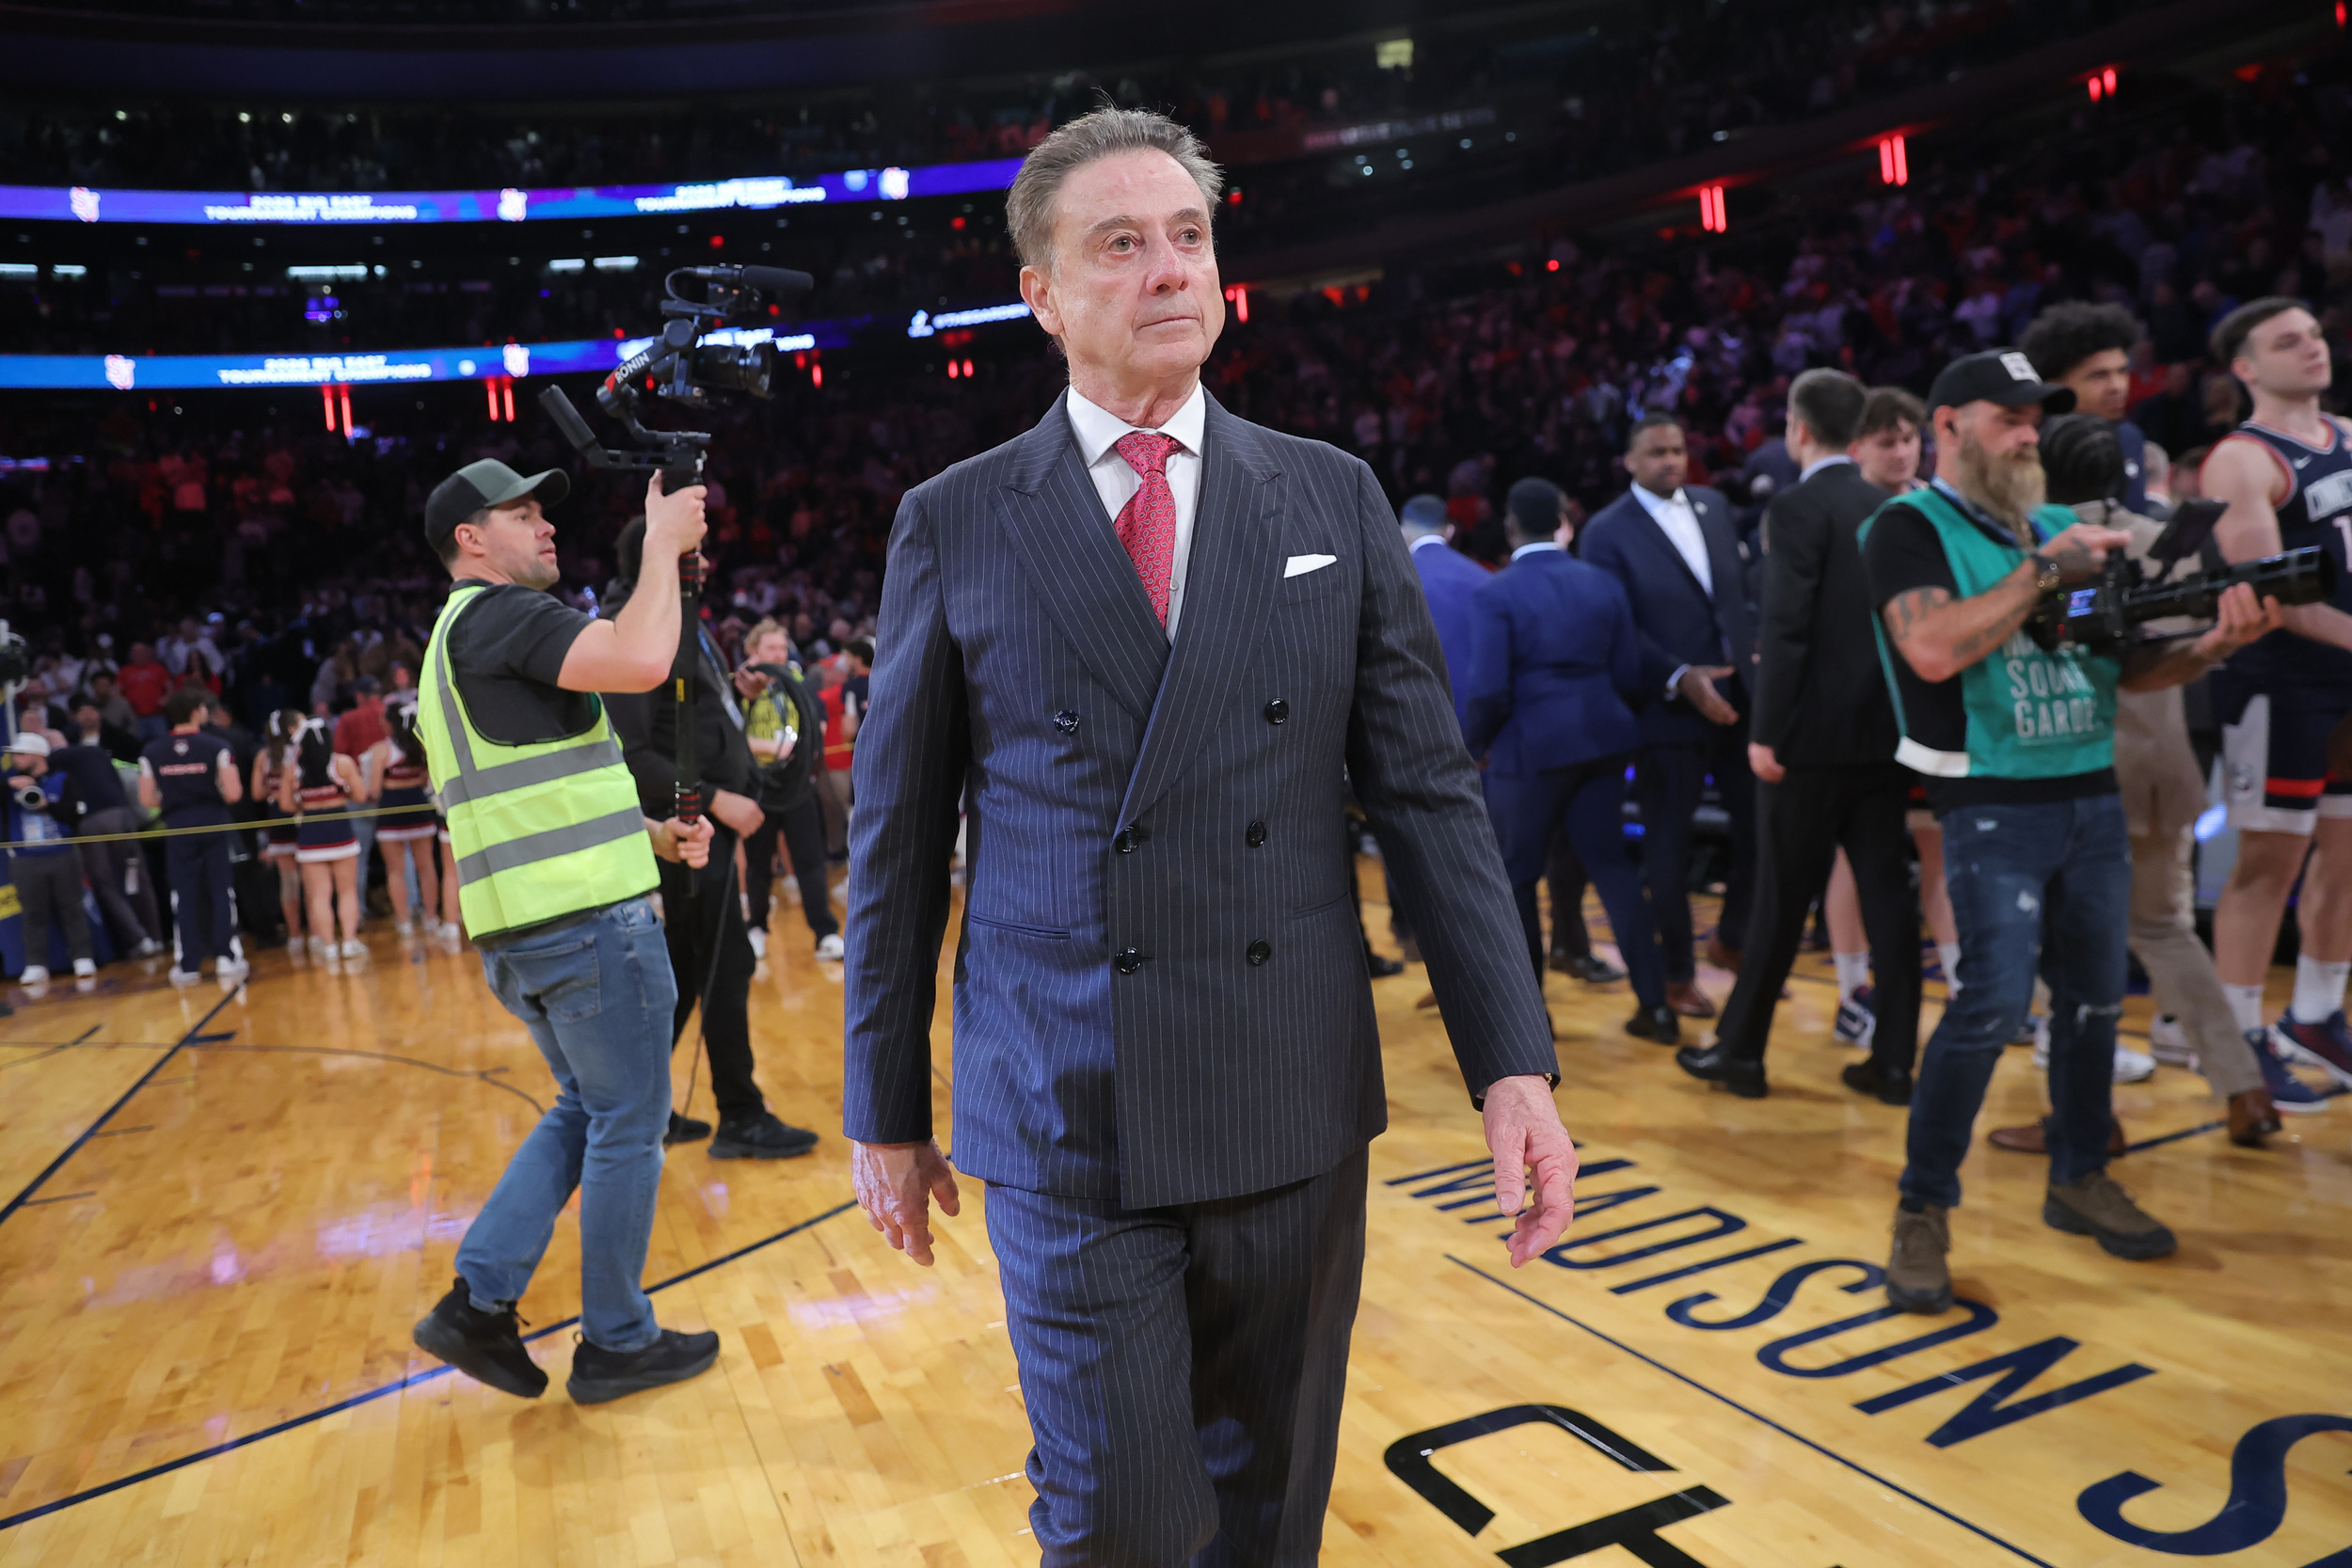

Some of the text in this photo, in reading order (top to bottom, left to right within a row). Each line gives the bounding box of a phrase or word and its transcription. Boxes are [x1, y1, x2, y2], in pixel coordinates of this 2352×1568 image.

[297, 195, 328, 208] BIG
[329, 195, 373, 208] EAST
[203, 205, 418, 220] TOURNAMENT CHAMPIONS
[311, 356, 343, 370] BIG
[344, 355, 387, 369] EAST
[614, 352, 651, 384] RONIN
[217, 363, 432, 384] TOURNAMENT CHAMPIONS
[2014, 696, 2106, 738] GARDE
[1384, 1140, 2158, 1449] MADISON
